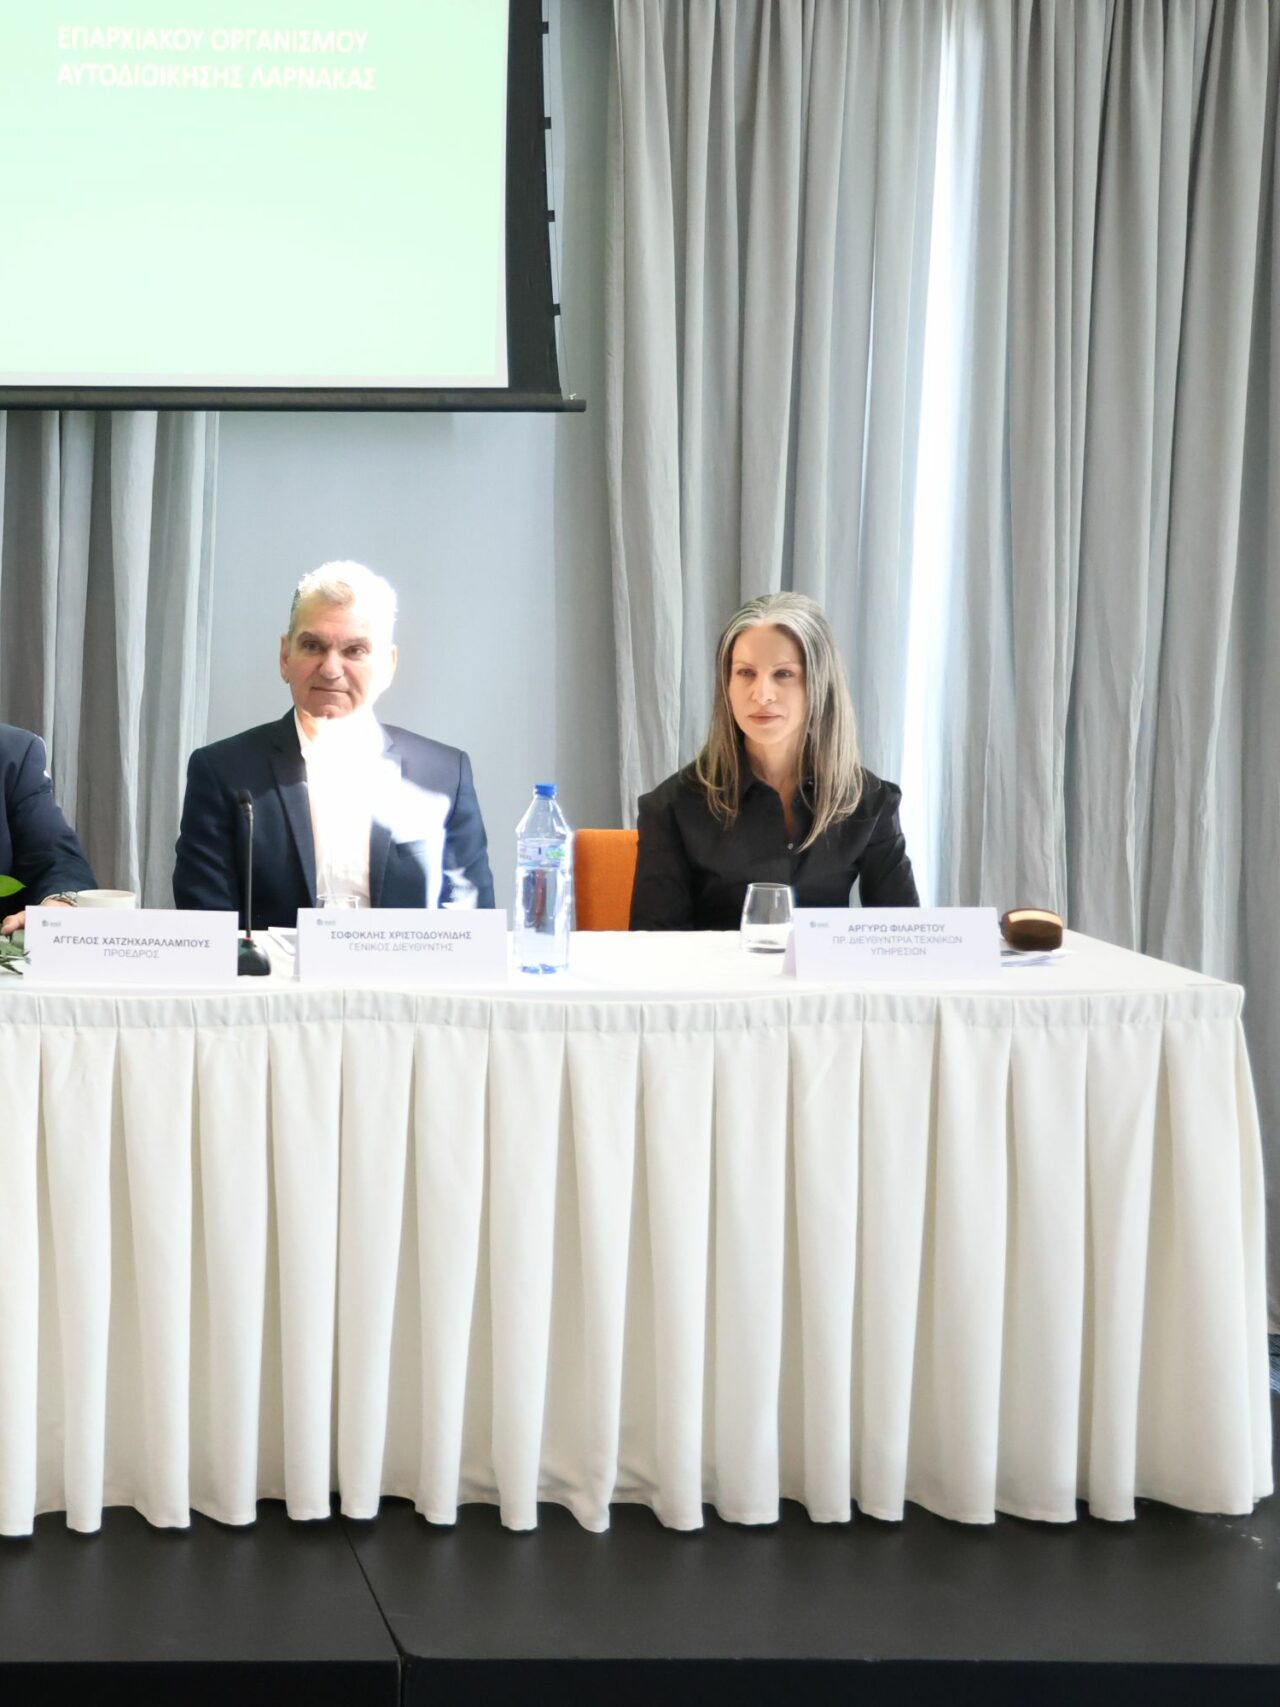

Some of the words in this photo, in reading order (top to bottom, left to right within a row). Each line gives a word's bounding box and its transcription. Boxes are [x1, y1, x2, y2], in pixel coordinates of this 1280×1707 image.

[57, 26, 205, 52] ΕΠΑΡΧΙΑΚΟΥ
[210, 28, 369, 53] ΟΡΓΑΝΙΣΜΟΥ
[56, 63, 243, 89] ΑΥΤΟΔΙΟΙΚΗΣΗΣ
[249, 65, 377, 91] ΛΑΡΝΑΚΑΣ
[848, 924, 888, 933] ΑΡΓΥΡΩ
[890, 924, 946, 933] ΦΙΛΑΡΕΤΟΥ
[330, 931, 386, 940] ΣΟΦΟΚΛΗΣ
[388, 931, 472, 940] ΧΡΙΣΤΟΔΟΥΛΙΔΗΣ
[53, 936, 99, 945] ΑΓΓΕΛΟΣ
[102, 937, 210, 948] ΧΑΤΖΗΧΑΡΑΛΑΜΠΟΥΣ
[349, 943, 390, 951] ΓΕΝΙΚΟΣ
[392, 943, 454, 952] ΔΙΕΥΘΥΝΤΗΣ
[104, 949, 159, 958] ΠΡΟΕΔΡΟΣ
